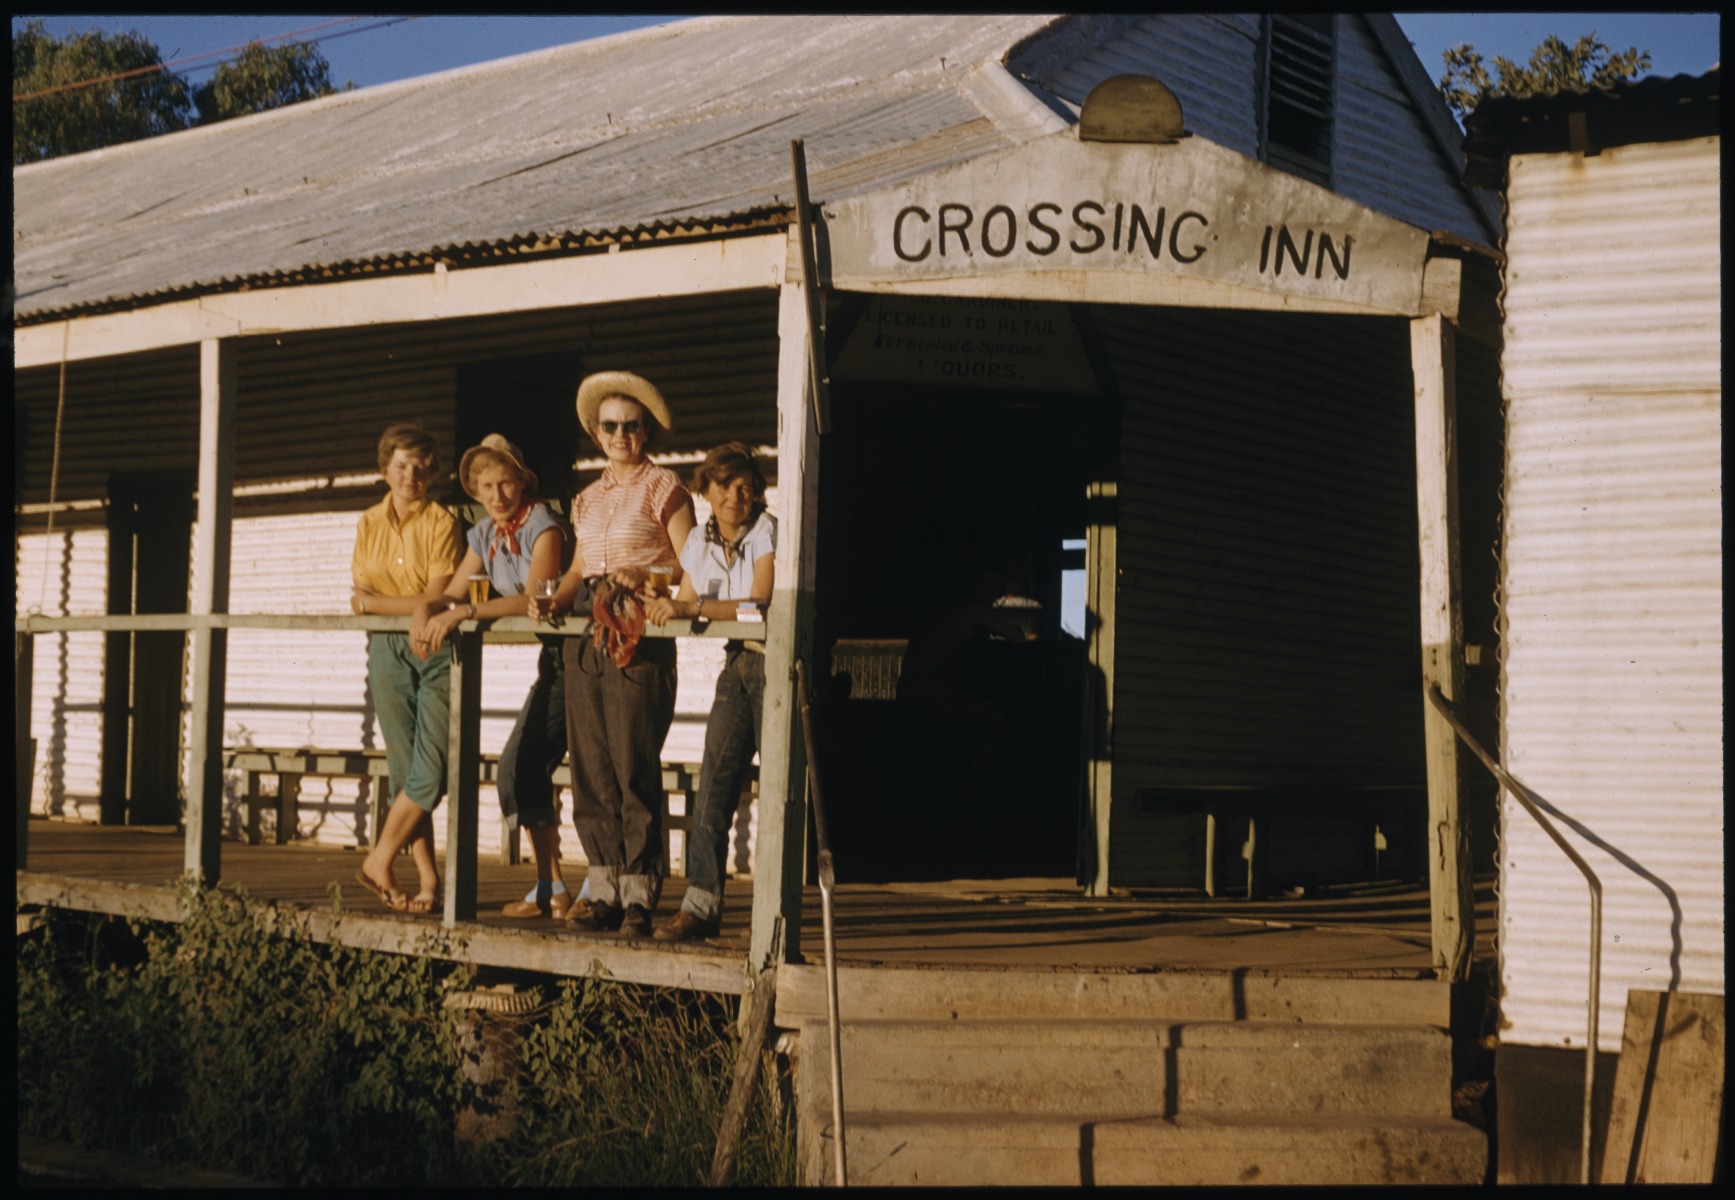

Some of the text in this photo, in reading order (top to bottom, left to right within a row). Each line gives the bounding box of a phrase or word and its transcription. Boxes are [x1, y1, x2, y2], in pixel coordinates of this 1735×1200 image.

[893, 200, 1353, 280] CROSSING INN
[866, 306, 1056, 335] LICENSED TO RETAIL
[961, 340, 973, 353] &
